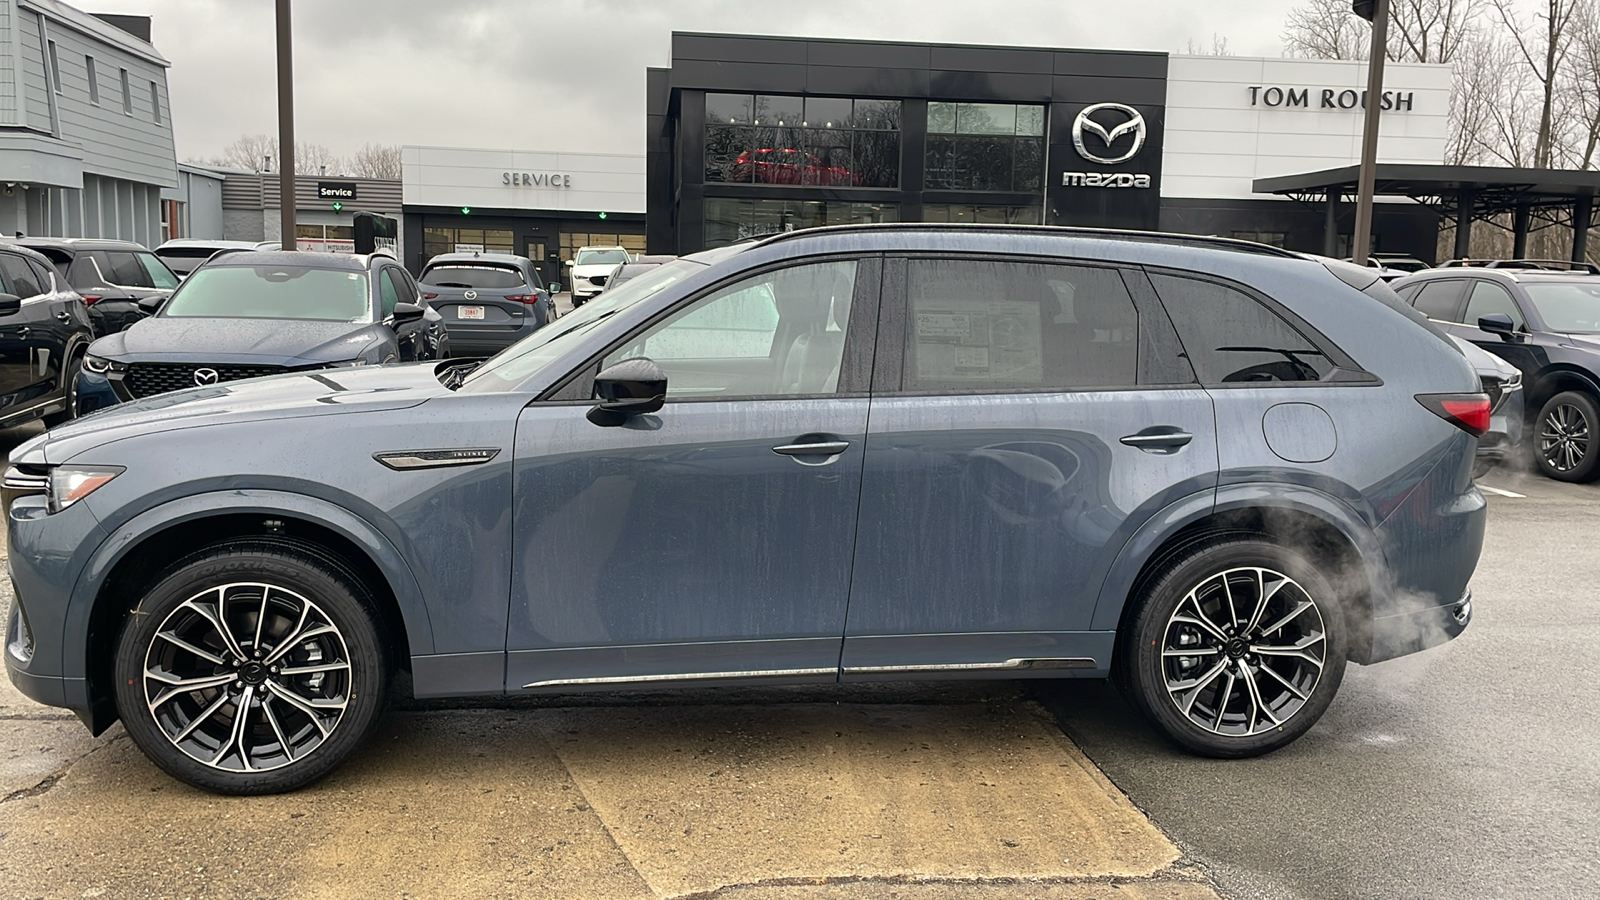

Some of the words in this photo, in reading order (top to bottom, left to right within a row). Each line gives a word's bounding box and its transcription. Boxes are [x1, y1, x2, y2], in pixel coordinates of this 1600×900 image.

[1248, 86, 1309, 108] TOM
[502, 172, 571, 188] SERVICE
[1062, 172, 1151, 189] mazda
[320, 187, 353, 197] Service
